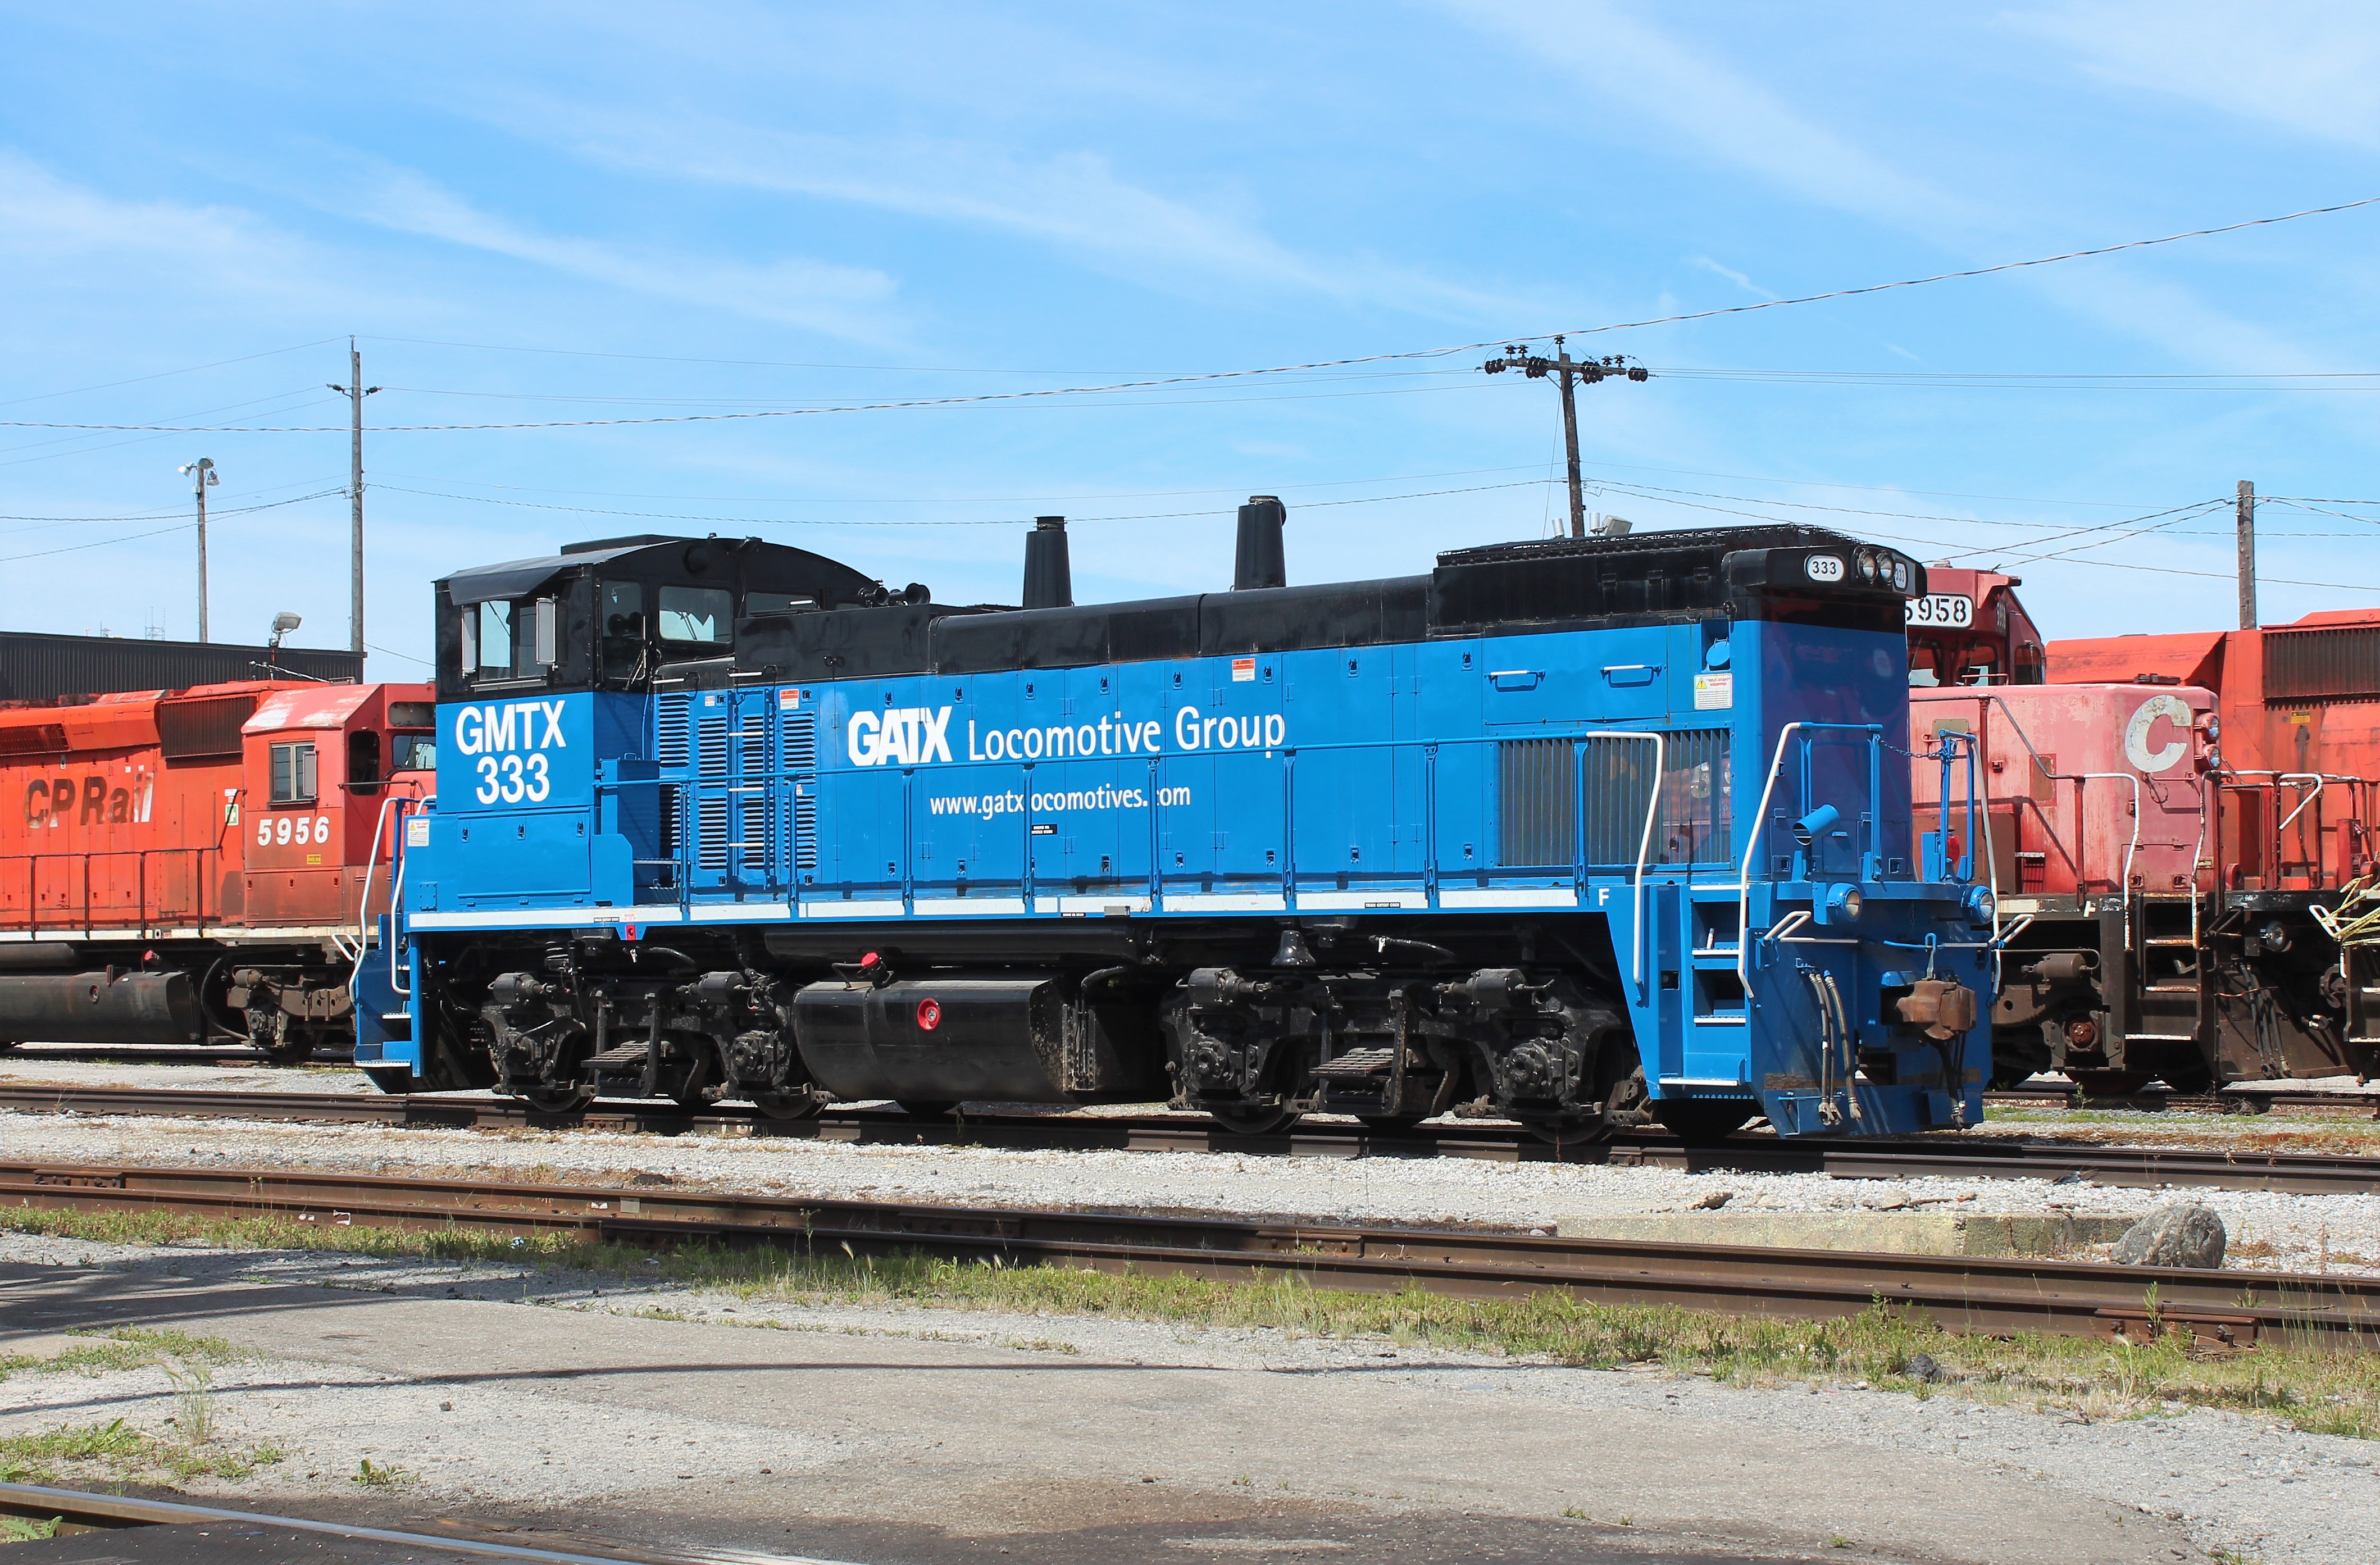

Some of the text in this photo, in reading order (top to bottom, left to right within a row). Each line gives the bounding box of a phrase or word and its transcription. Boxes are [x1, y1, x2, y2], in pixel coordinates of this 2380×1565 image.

[1812, 561, 1836, 574] 333
[456, 700, 567, 755] GMTX
[848, 706, 1285, 766] GATX Locomotive Group
[2125, 695, 2191, 772] C
[24, 772, 154, 829] CP Rail
[476, 753, 550, 804] 333
[930, 783, 1190, 820] www.gatxocomotives.om
[257, 816, 329, 846] 5956
[1599, 888, 1609, 906] F
